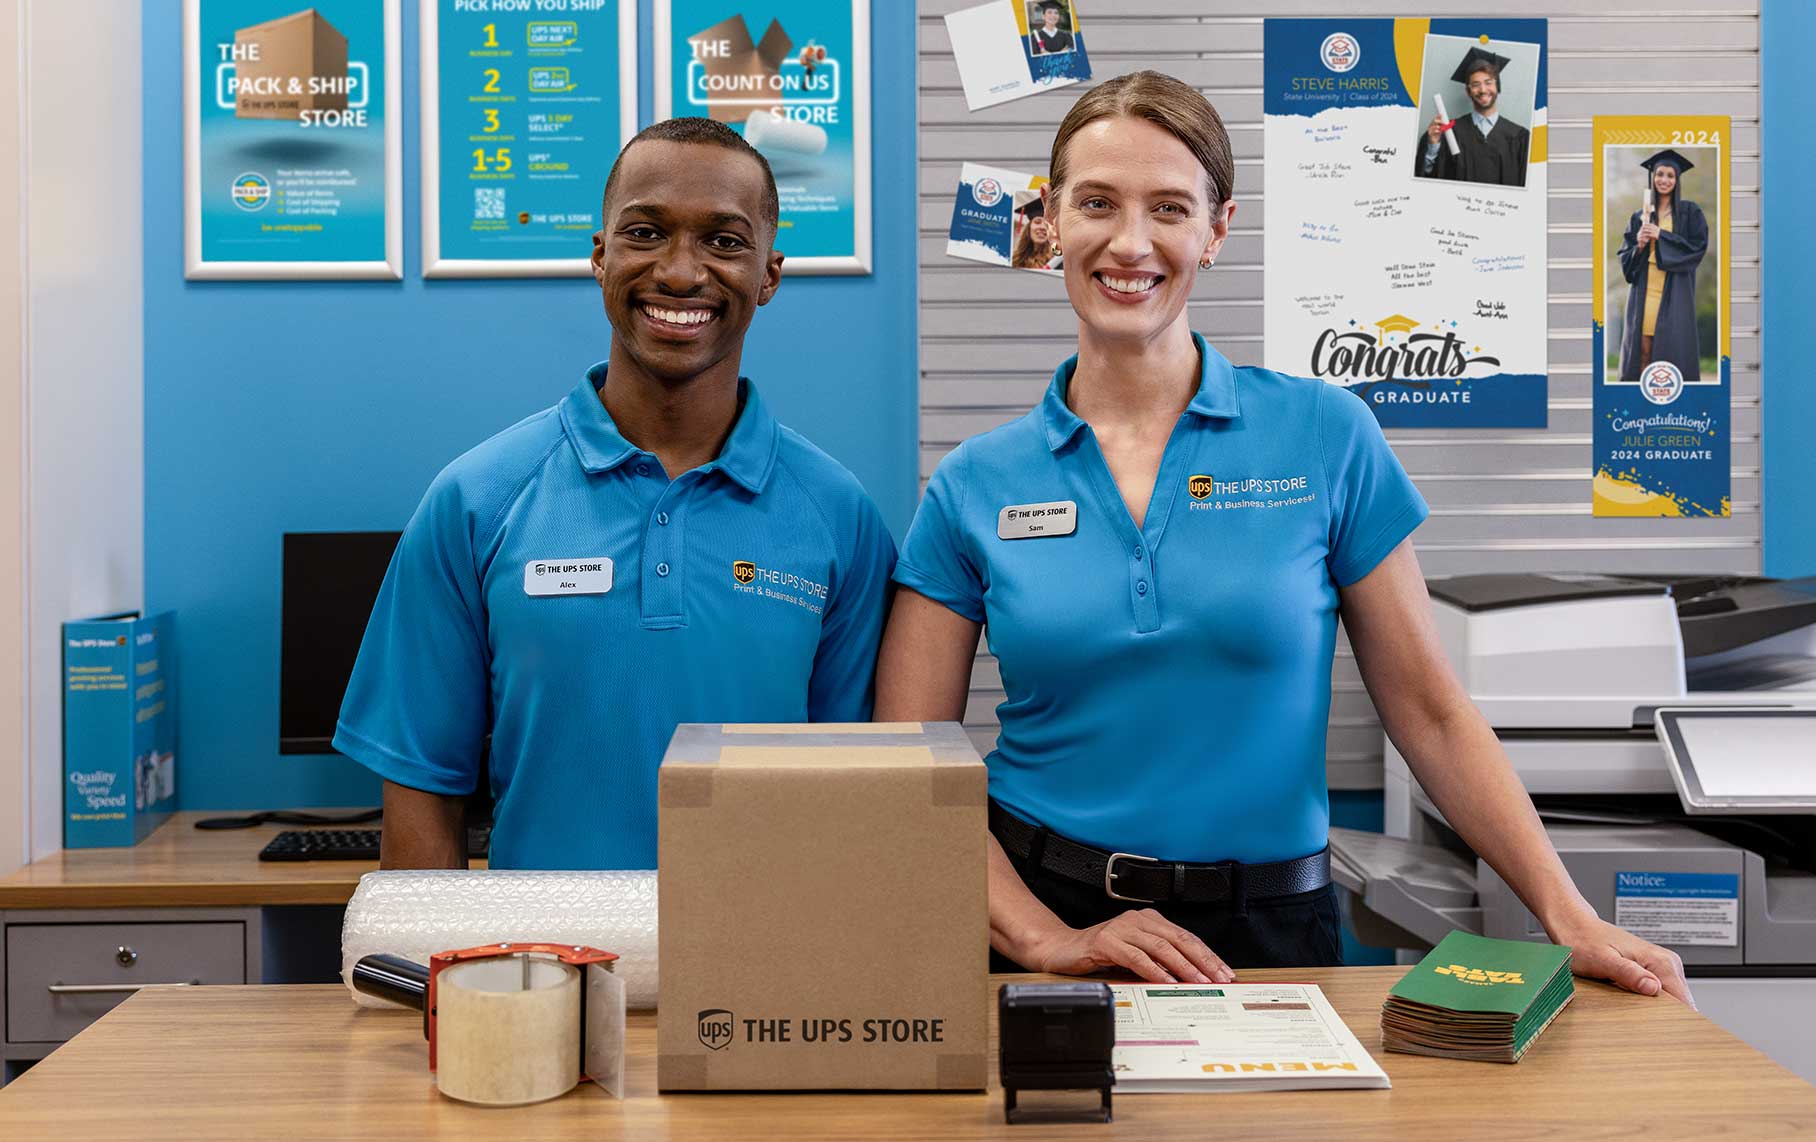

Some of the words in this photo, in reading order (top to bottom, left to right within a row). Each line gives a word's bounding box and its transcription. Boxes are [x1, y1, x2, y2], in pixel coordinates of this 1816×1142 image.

[454, 0, 488, 11] PICK
[492, 0, 531, 11] HOW
[535, 0, 567, 11] YOU
[570, 0, 606, 11] SHIP
[482, 23, 499, 47] 1
[531, 26, 548, 34] UPS
[550, 26, 573, 34] NEXT
[218, 43, 261, 61] THE
[689, 40, 731, 58] THE
[228, 77, 282, 95] PACK
[287, 77, 303, 95] &
[308, 77, 358, 95] SHIP
[483, 69, 501, 93] 2
[698, 74, 765, 91] COUNT
[769, 74, 800, 91] ON
[804, 74, 829, 91] US
[1292, 78, 1335, 90] STEVE
[1338, 78, 1389, 90] HARRIS
[1283, 92, 1303, 101] State
[1304, 92, 1340, 102] University
[1349, 92, 1369, 101] Class
[1371, 92, 1379, 100] of
[1380, 92, 1398, 101] 2024
[299, 109, 368, 127] STORE
[483, 109, 500, 132] 3
[528, 114, 546, 122] UPS
[770, 106, 839, 124] STORE
[1671, 131, 1720, 145] 2024
[472, 148, 512, 171] 1-5
[532, 214, 546, 222] THE
[549, 214, 565, 222] UPS
[568, 214, 592, 222] STORE
[961, 208, 1008, 224] GRADUATE
[1311, 328, 1500, 392] Congrats
[1374, 391, 1471, 403] GRADUATE
[1652, 388, 1671, 396] STATE
[1612, 413, 1711, 434] Congratulations!
[1622, 435, 1654, 447] JULIE
[1657, 435, 1702, 447] GREEN
[1611, 450, 1640, 460] 2024
[1645, 450, 1712, 460] GRADUATE
[1191, 482, 1210, 496] ups
[1214, 482, 1239, 494] THE
[1241, 479, 1262, 493] UPS
[1265, 476, 1307, 493] STORE
[1019, 509, 1031, 518] THE
[1033, 507, 1046, 517] UPS
[1047, 506, 1068, 516] STORE
[1190, 501, 1212, 510] Print
[1215, 501, 1222, 510] &
[1225, 499, 1265, 510] Business
[1028, 524, 1044, 532] Sam
[547, 565, 561, 574] THE
[563, 564, 577, 573] UPS
[579, 564, 602, 572] STORE
[560, 581, 577, 589] Alex
[735, 566, 754, 580] ups
[757, 567, 780, 584] THE
[780, 572, 800, 589] UPS
[800, 578, 829, 599] STORE
[733, 583, 755, 594] Print
[757, 586, 763, 595] &
[765, 588, 798, 605] Business
[70, 770, 117, 786] Quality
[86, 793, 126, 810] Speed
[1619, 873, 1666, 887] Notice:
[701, 1022, 731, 1044] ups
[743, 1019, 791, 1042] THE
[802, 1019, 853, 1042] UPS
[862, 1019, 944, 1042] STORE
[1202, 1062, 1359, 1073] MENU
